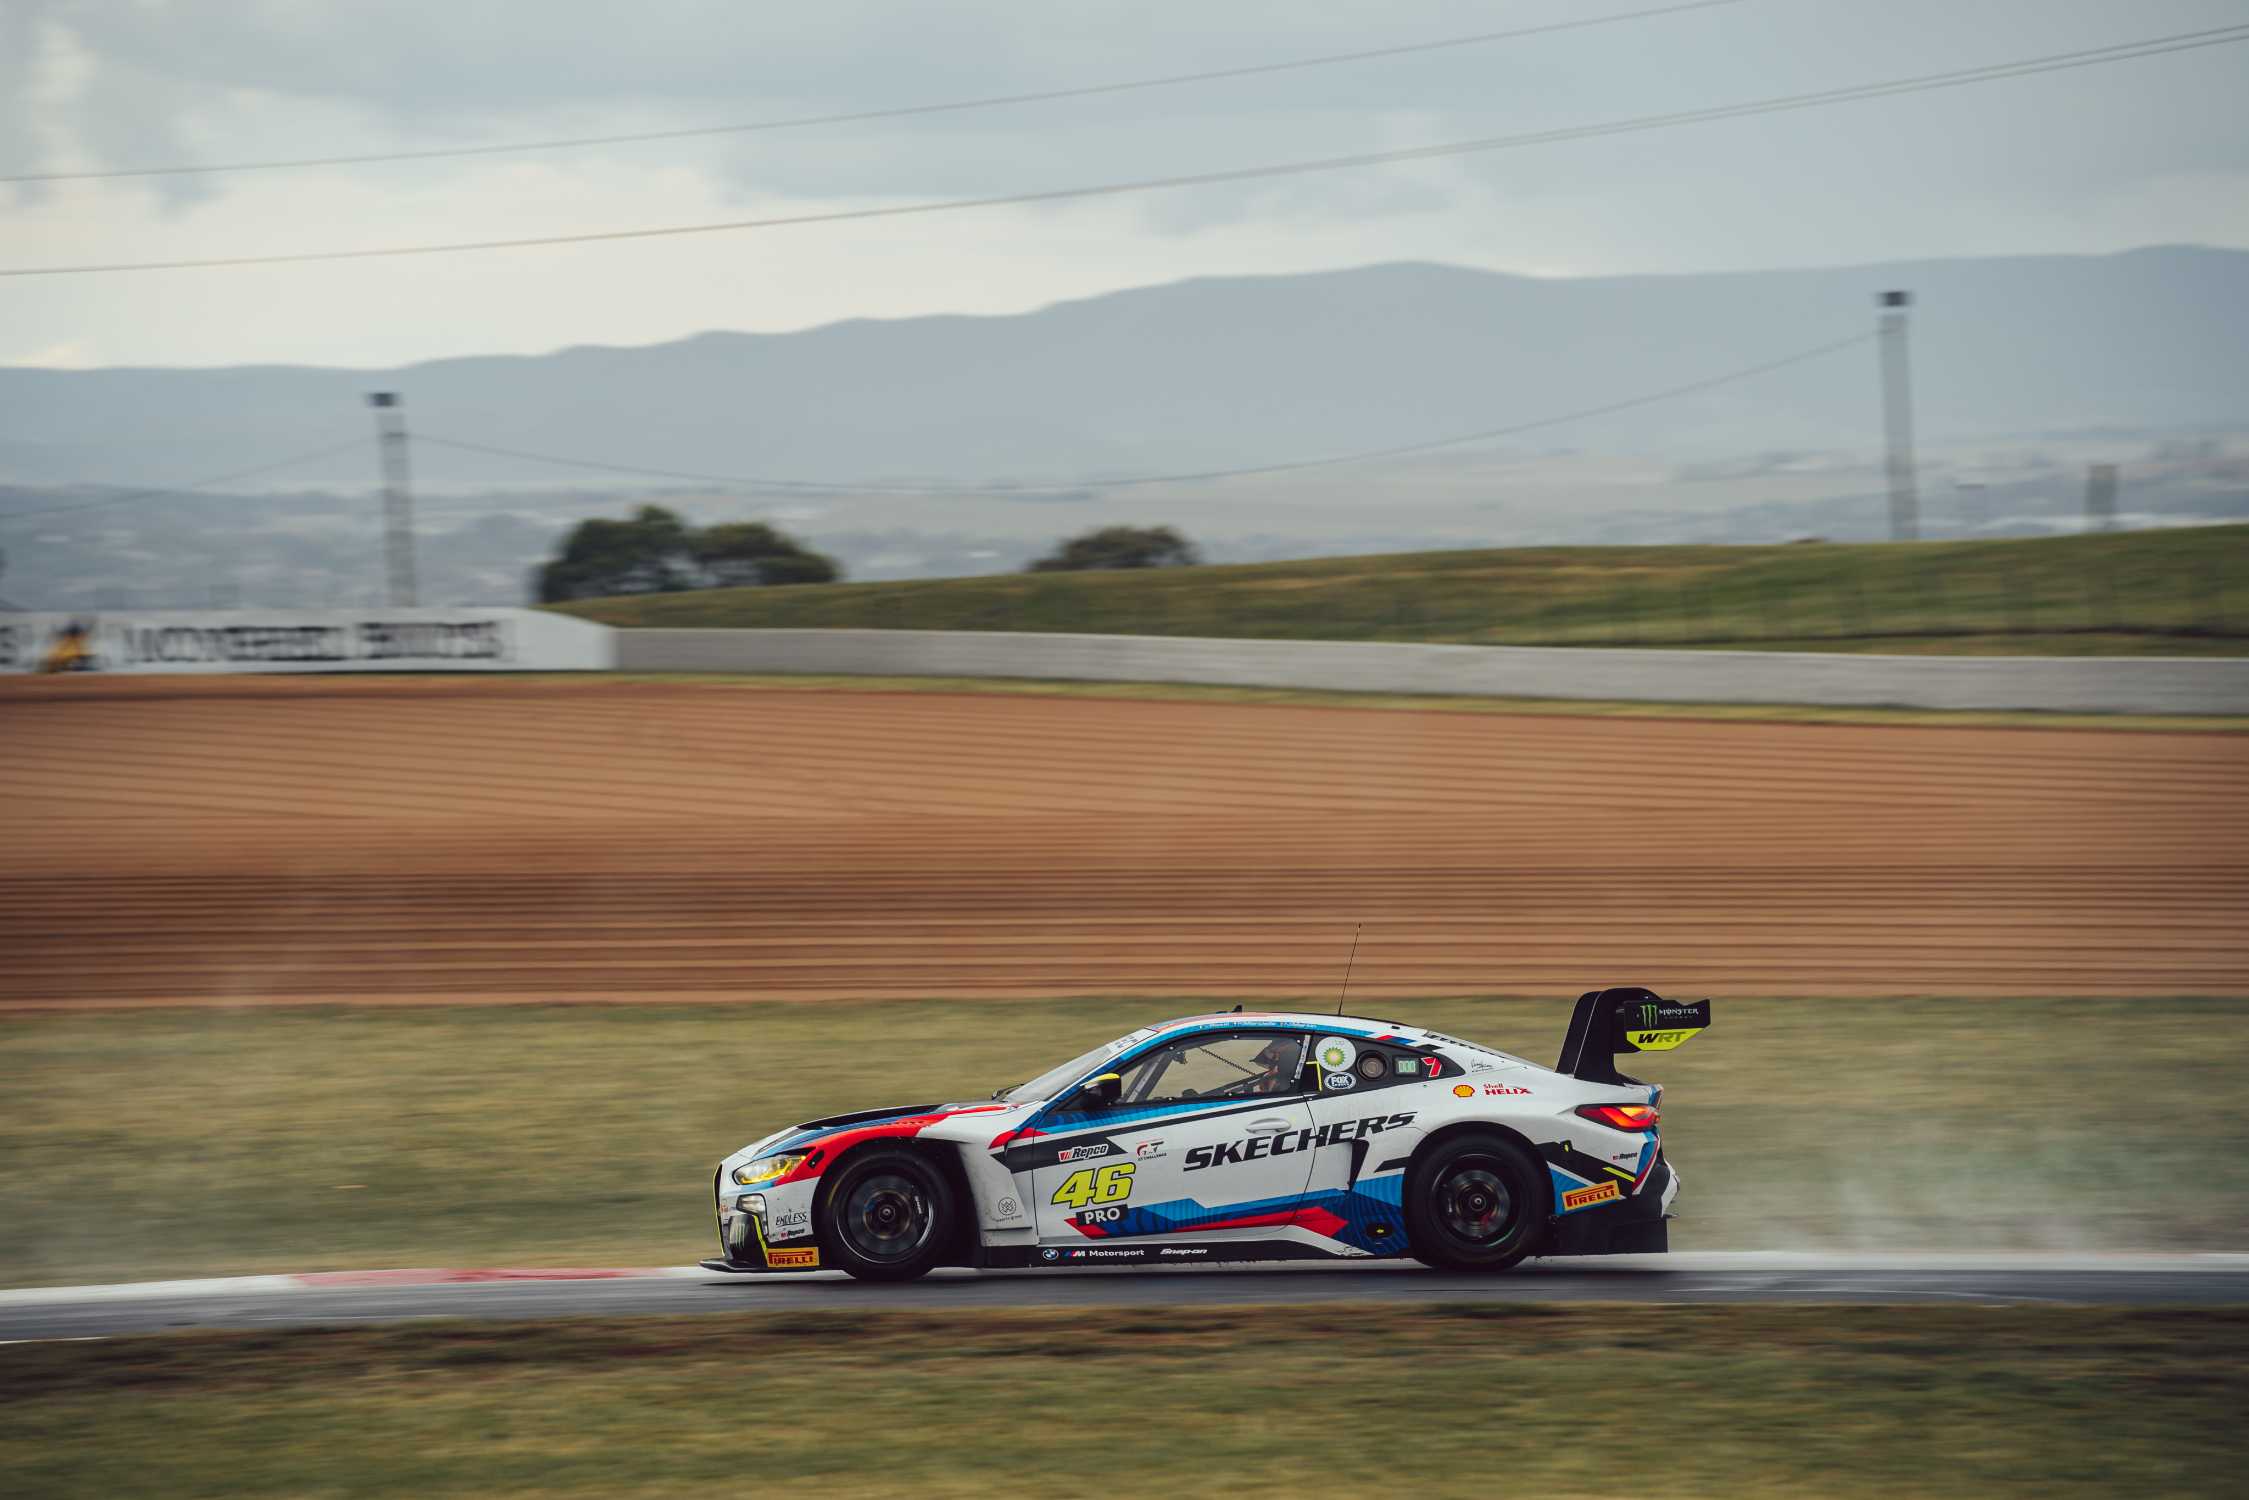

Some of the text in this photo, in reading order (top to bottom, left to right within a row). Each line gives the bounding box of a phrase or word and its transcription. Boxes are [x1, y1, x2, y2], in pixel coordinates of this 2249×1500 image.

[1659, 1008, 1699, 1016] MONSTER
[1638, 1031, 1686, 1043] WRT
[1420, 1056, 1442, 1078] 7
[1330, 1075, 1349, 1084] FOX
[1485, 1086, 1533, 1096] HELIX
[1184, 1111, 1418, 1172] SKECHERS
[1072, 1145, 1108, 1159] Repco
[1051, 1162, 1136, 1209] 46
[1565, 1184, 1616, 1208] PIRELLI
[776, 1212, 808, 1226] ENDLESS
[1084, 1208, 1121, 1224] PRO
[767, 1250, 814, 1265] PIRELLI
[1089, 1249, 1145, 1257] Motorsport
[1159, 1248, 1208, 1256] Snap-on
